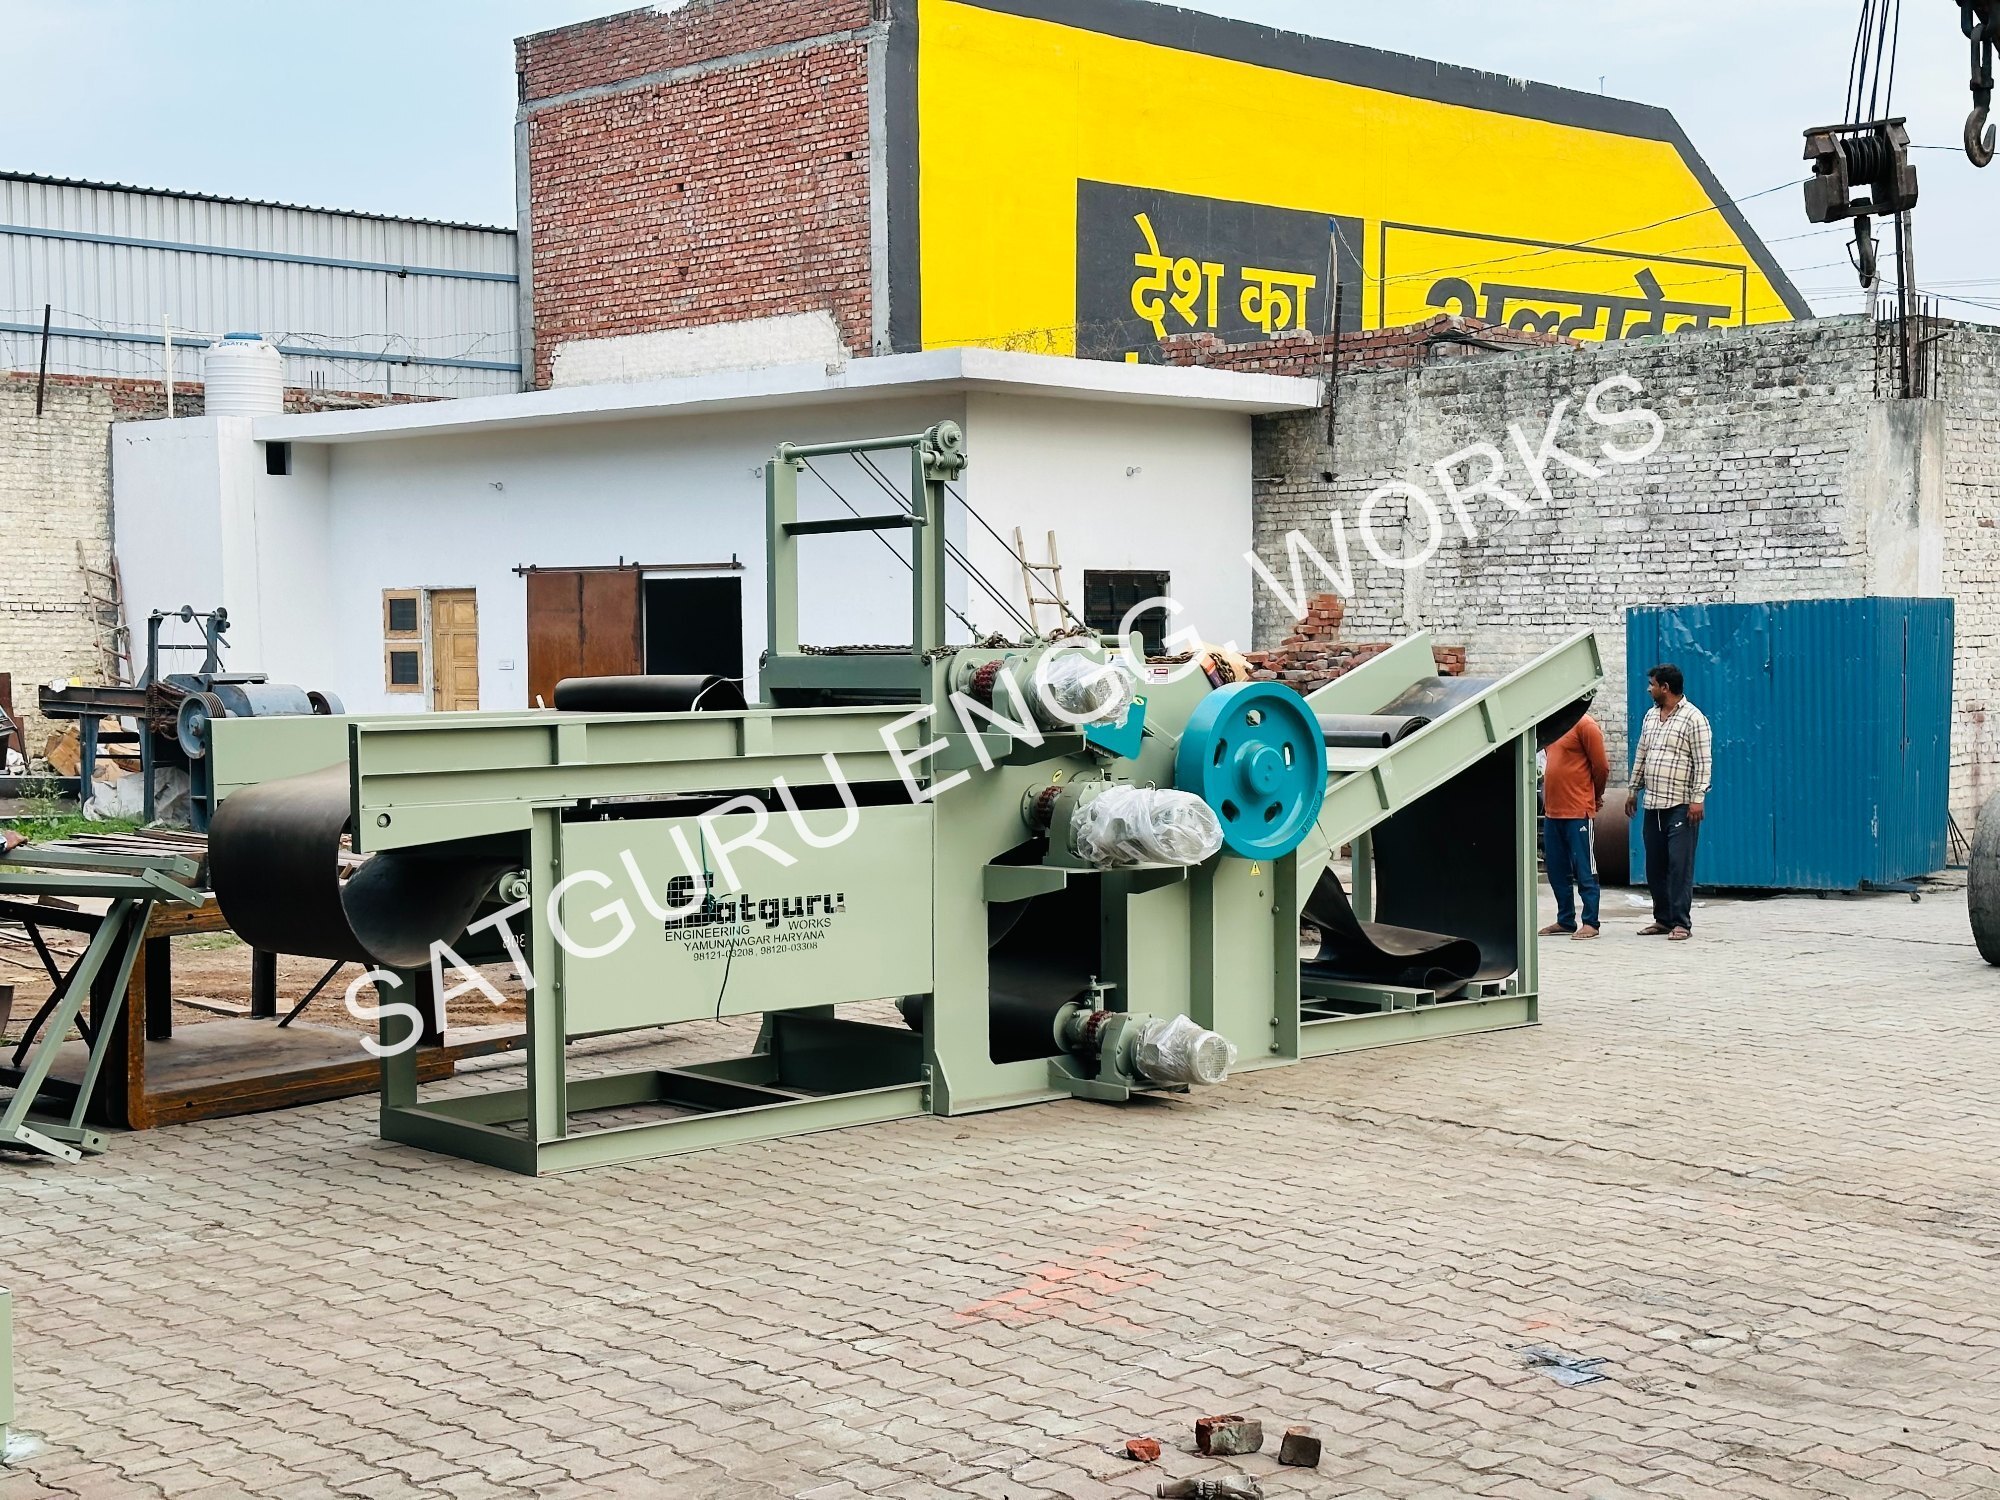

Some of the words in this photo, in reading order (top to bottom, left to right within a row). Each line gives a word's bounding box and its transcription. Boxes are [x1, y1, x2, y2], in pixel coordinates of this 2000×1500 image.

[1130, 212, 1225, 341] देश
[1239, 266, 1317, 335] का
[665, 925, 750, 942] ENGINEERING
[788, 918, 832, 931] WORKS
[684, 934, 771, 952] YAMUNANAGAR
[773, 930, 825, 944] HARYANA
